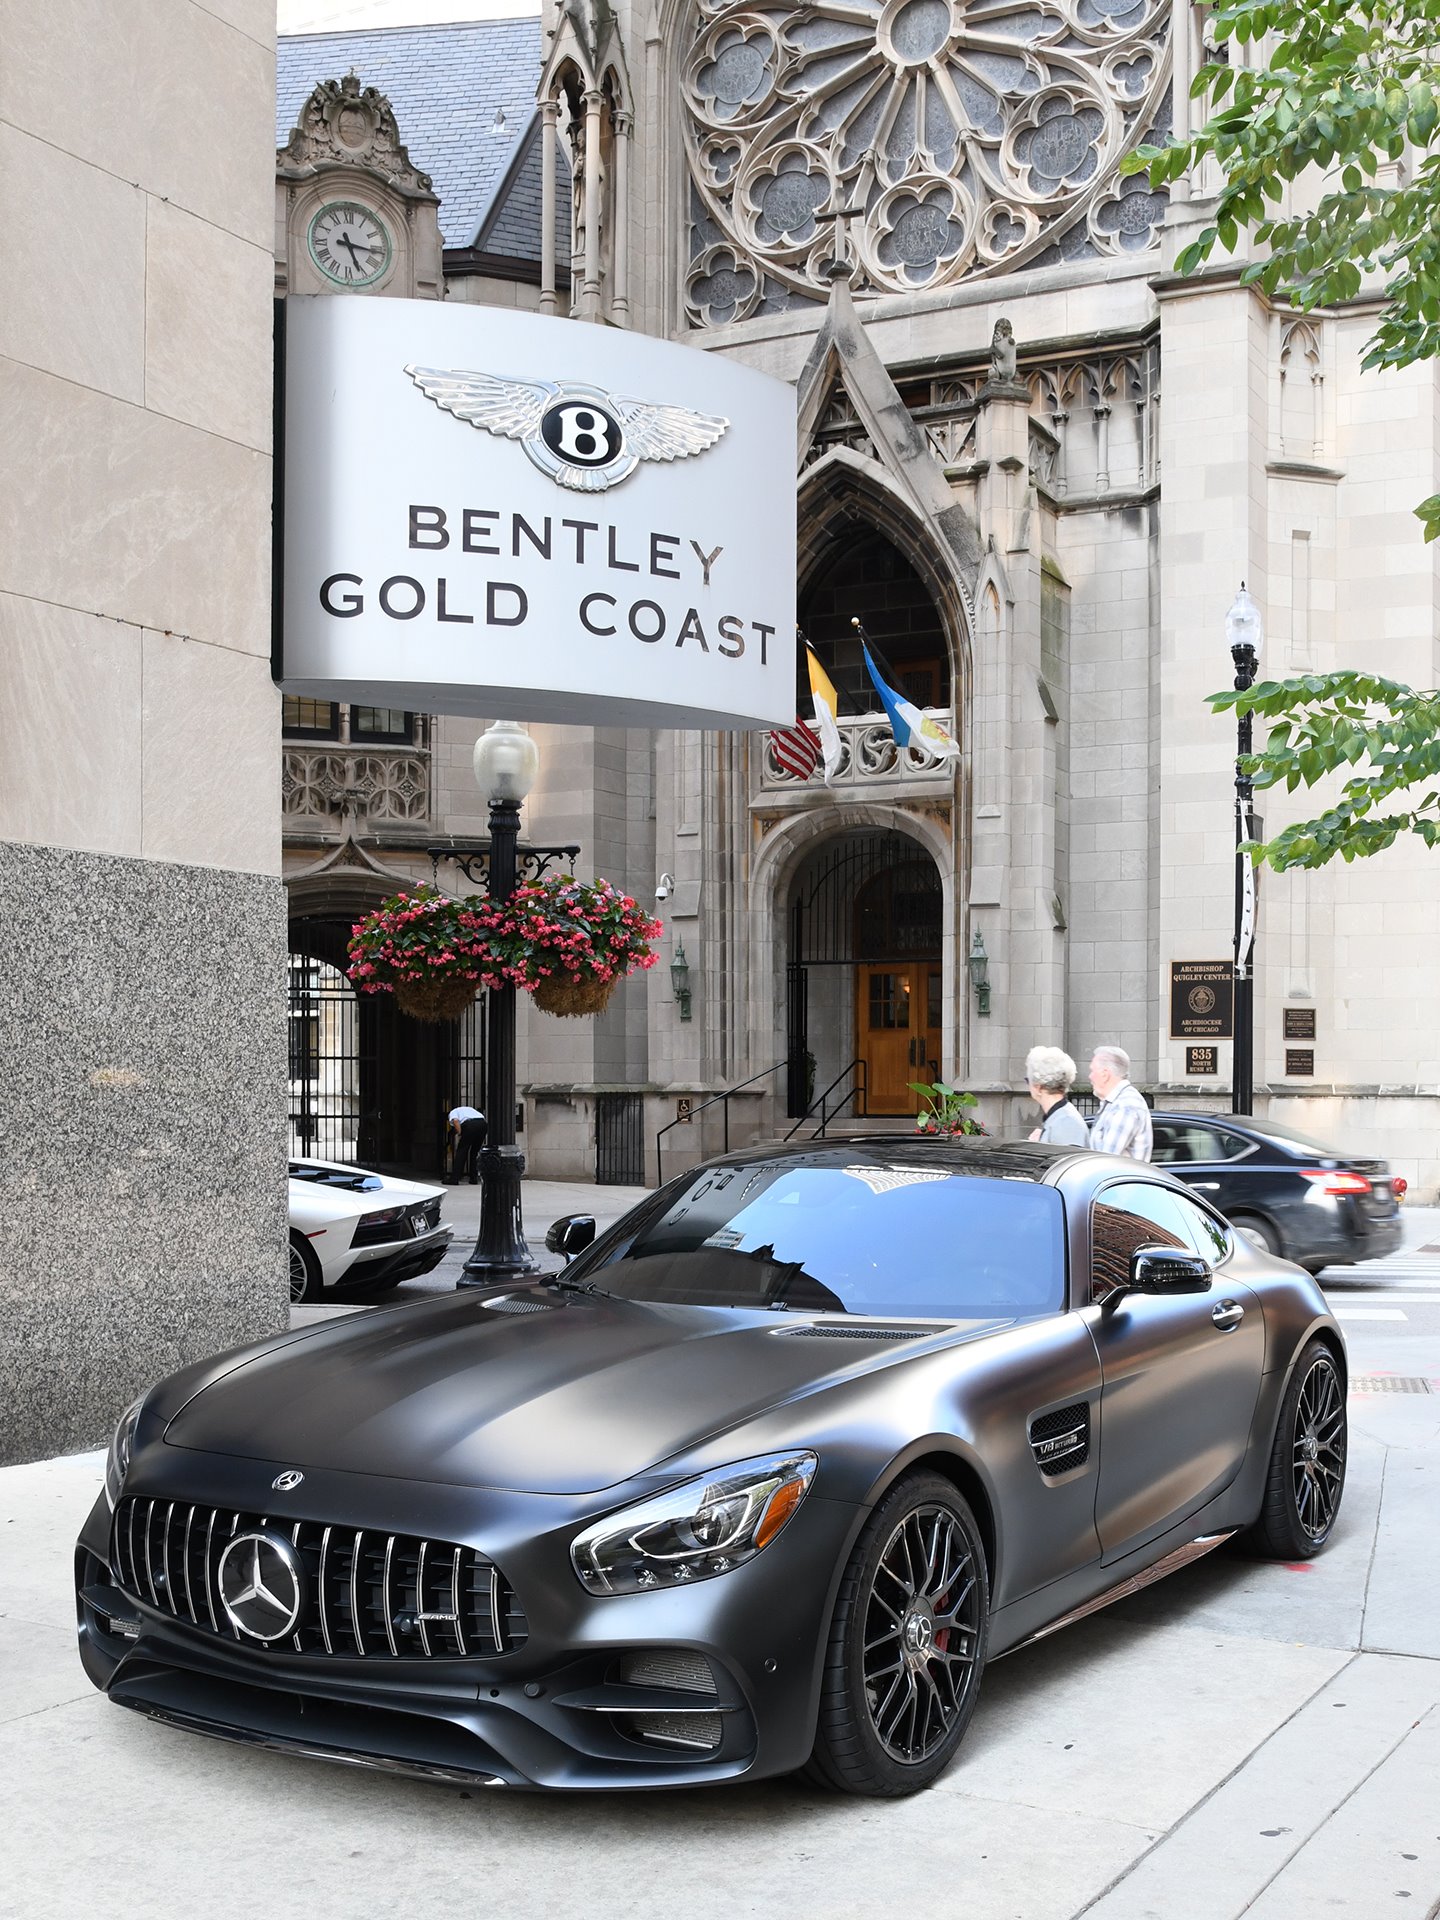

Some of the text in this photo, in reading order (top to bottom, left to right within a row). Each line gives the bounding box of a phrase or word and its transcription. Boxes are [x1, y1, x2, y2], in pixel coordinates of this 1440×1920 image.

[558, 406, 609, 460] B
[408, 504, 724, 586] BENTLEY
[319, 572, 776, 666] GOLD COAST
[1181, 965, 1224, 973] ARCHBISHOP
[1173, 974, 1203, 982] QUIGLEY
[1191, 1048, 1212, 1060] 835
[1040, 1441, 1054, 1454] V8
